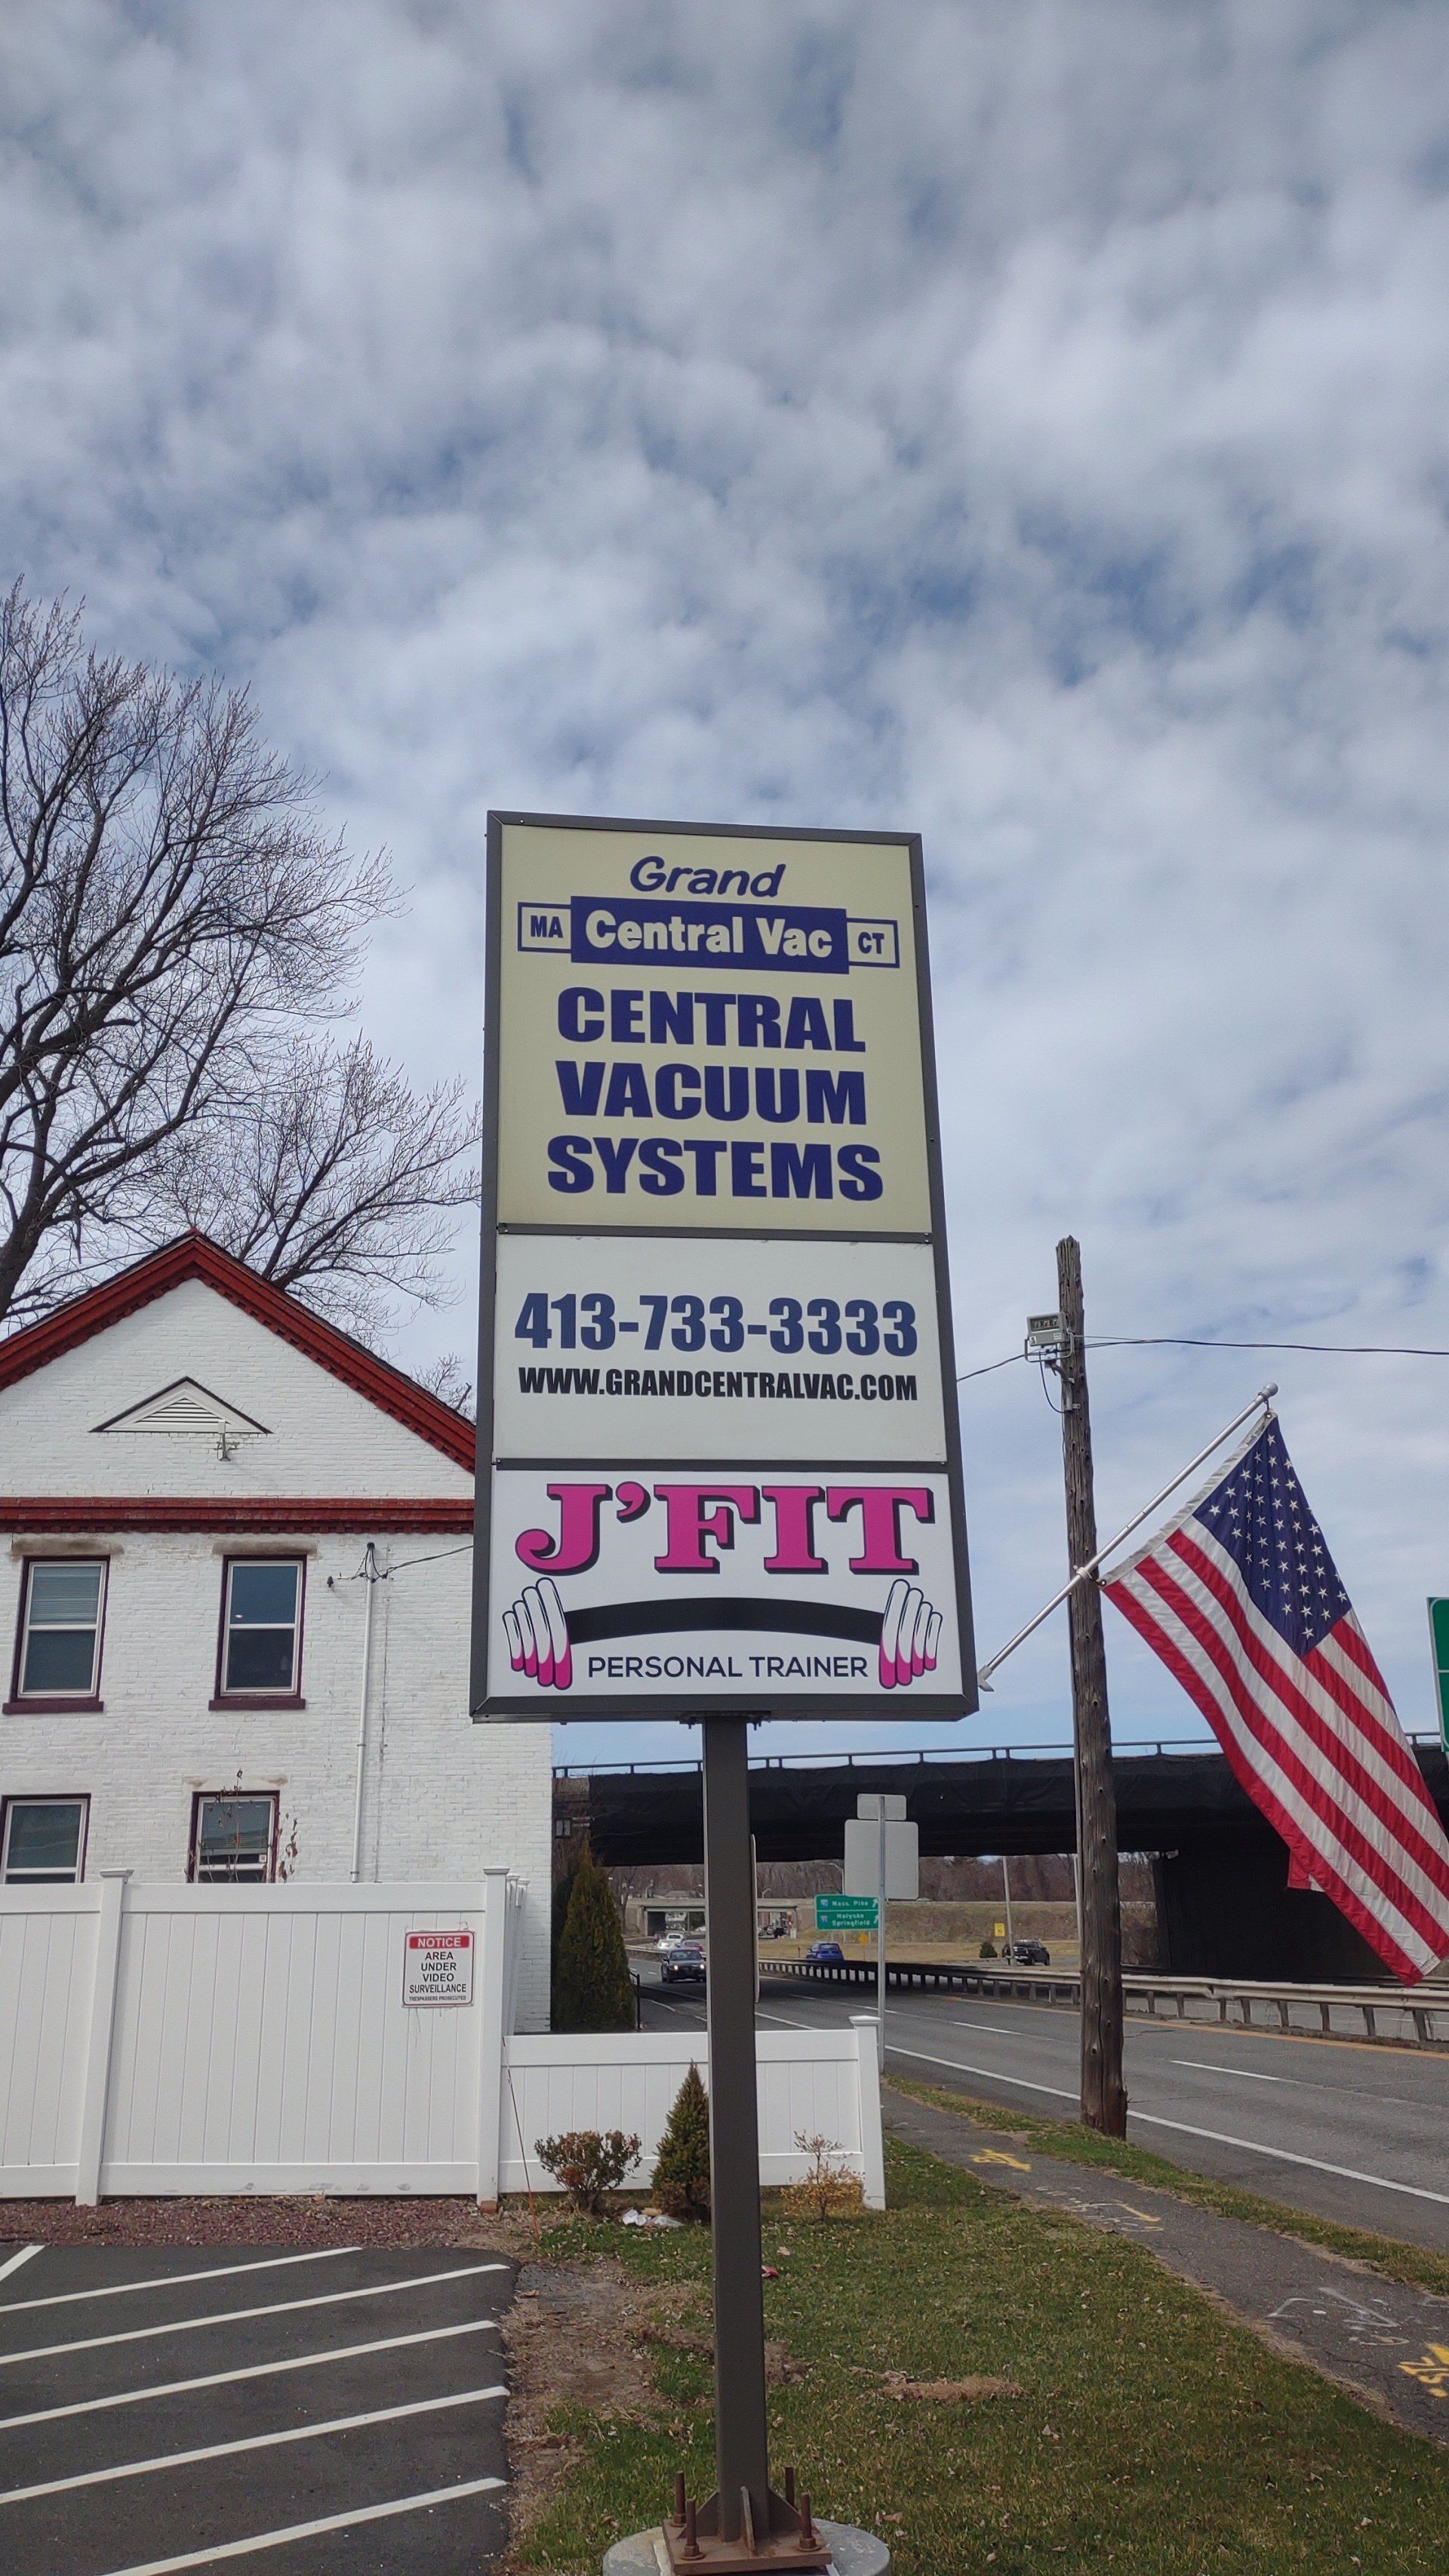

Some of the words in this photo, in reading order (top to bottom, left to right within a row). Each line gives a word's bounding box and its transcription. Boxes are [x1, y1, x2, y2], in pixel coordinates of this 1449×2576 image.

[629, 855, 786, 898] Grand
[530, 915, 564, 939] MA
[585, 909, 744, 954] Central
[755, 916, 832, 959] Vac
[857, 931, 884, 956] CT
[557, 986, 866, 1052] CENTRAL
[555, 1060, 867, 1125] VACUUM
[546, 1134, 884, 1202] SYSTEMS
[514, 1292, 918, 1357] 413-733-3333
[518, 1367, 918, 1401] WWW.GRANDCENTRALVAC.COM
[515, 1481, 936, 1575] J'FIT
[588, 1656, 743, 1678] PERSONAL
[749, 1656, 869, 1678] TRAINER
[417, 1937, 461, 1947] NOTICE
[425, 1951, 454, 1960] AREA
[421, 1962, 457, 1971] UNDER
[423, 1973, 454, 1982] VIDEO
[409, 1984, 466, 1993] SURVEILLANCE
